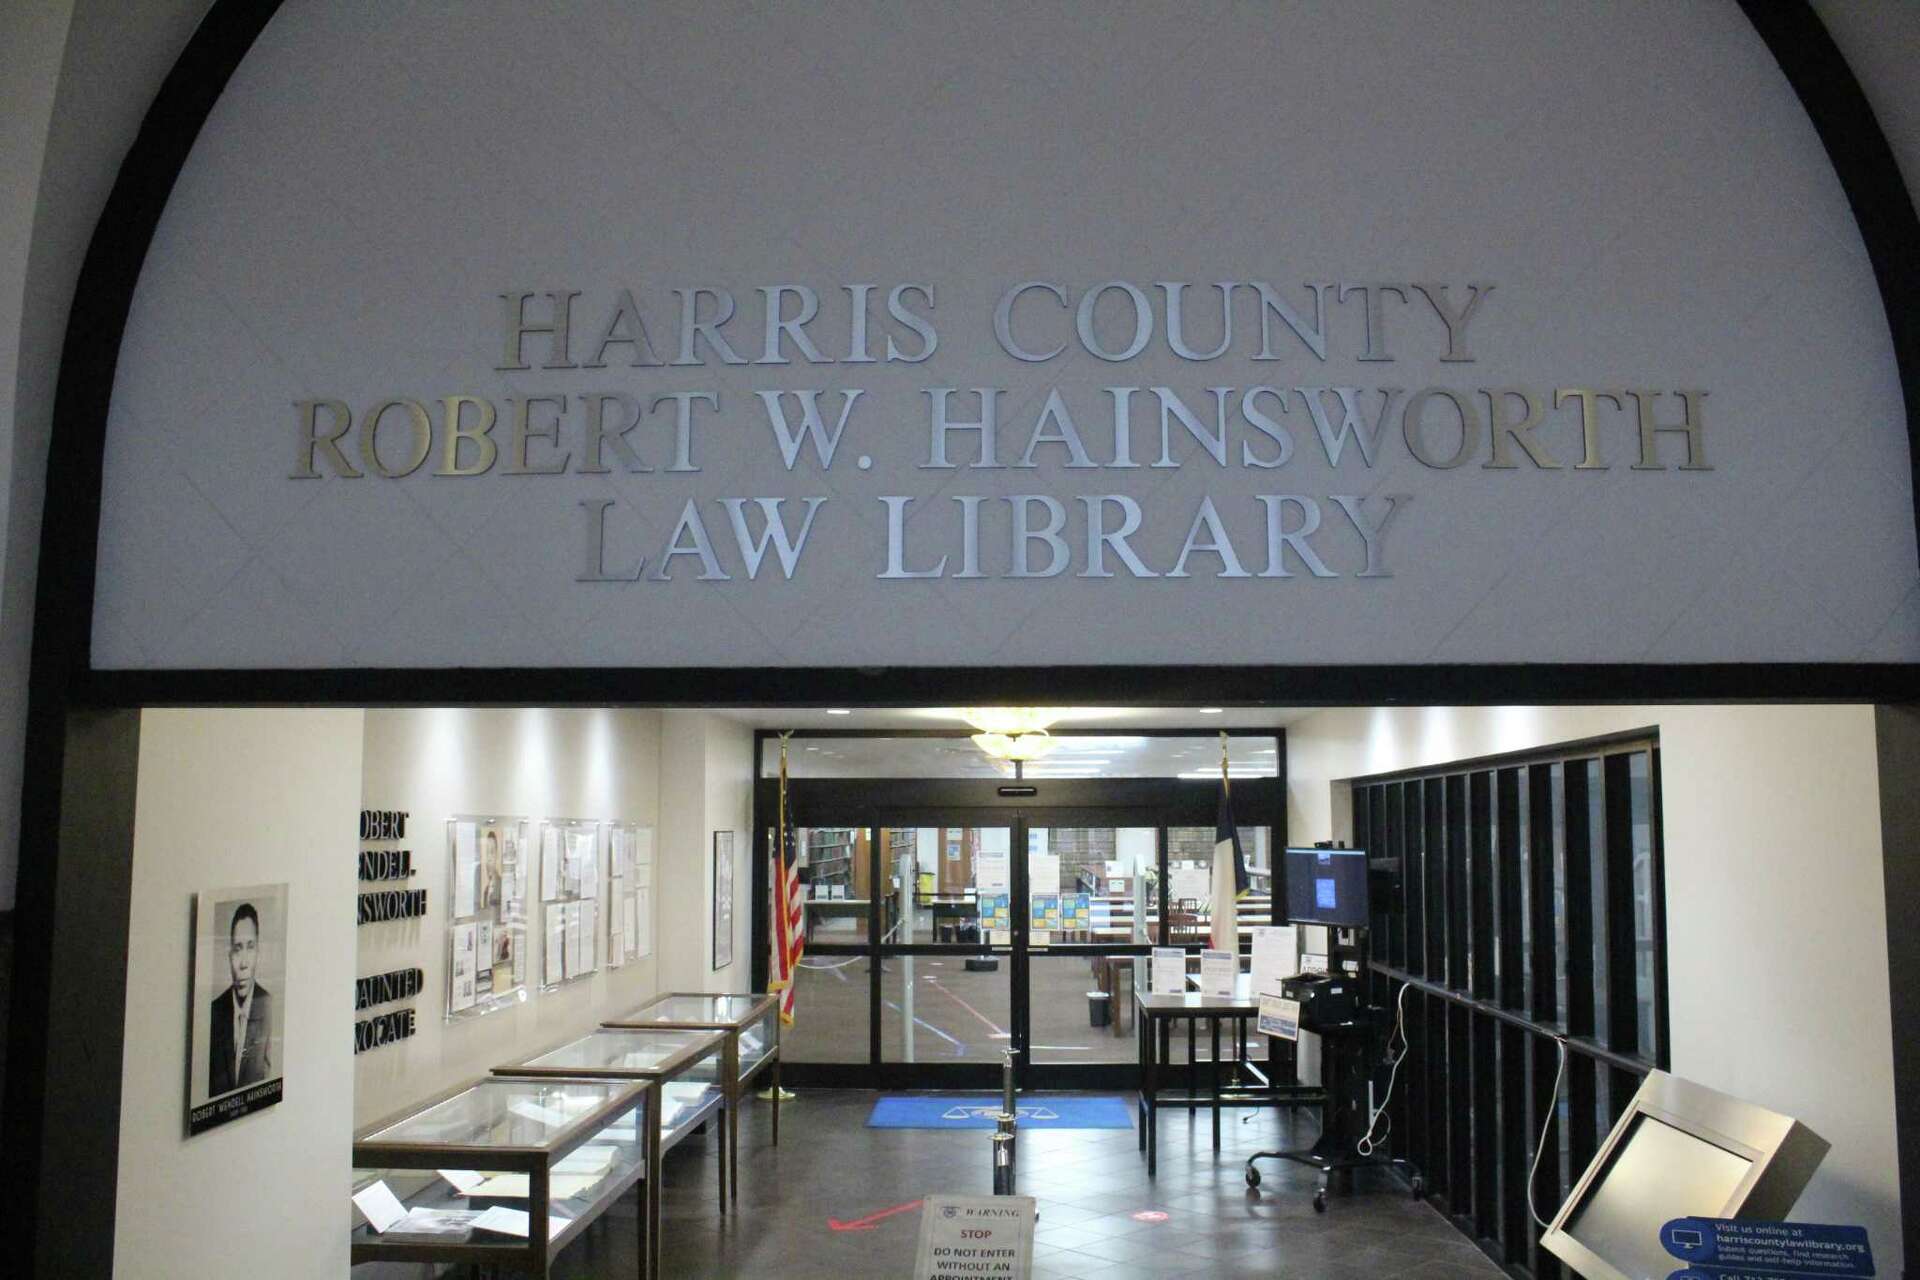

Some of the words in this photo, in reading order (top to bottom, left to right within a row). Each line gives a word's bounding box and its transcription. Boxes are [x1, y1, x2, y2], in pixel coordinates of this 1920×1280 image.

[494, 283, 940, 371] HARRIS
[994, 280, 1495, 363] COUNTY
[288, 389, 719, 480] ROBERT
[755, 388, 873, 472] W.
[918, 386, 1714, 472] HAINSWORTH
[575, 496, 827, 583] LAW
[876, 494, 1412, 580] LIBRARY
[966, 1208, 1020, 1217] WARNING
[960, 1229, 992, 1239] STOP
[1714, 1223, 1739, 1233] Visit
[1755, 1226, 1789, 1236] online
[1791, 1229, 1802, 1237] at
[1716, 1234, 1865, 1253] harriscountylawlibrary.org
[934, 1247, 951, 1256] DO
[953, 1248, 977, 1257] NOT
[980, 1249, 1015, 1258] ENTER
[936, 1261, 990, 1271] WITHOUT
[993, 1262, 1010, 1271] AN
